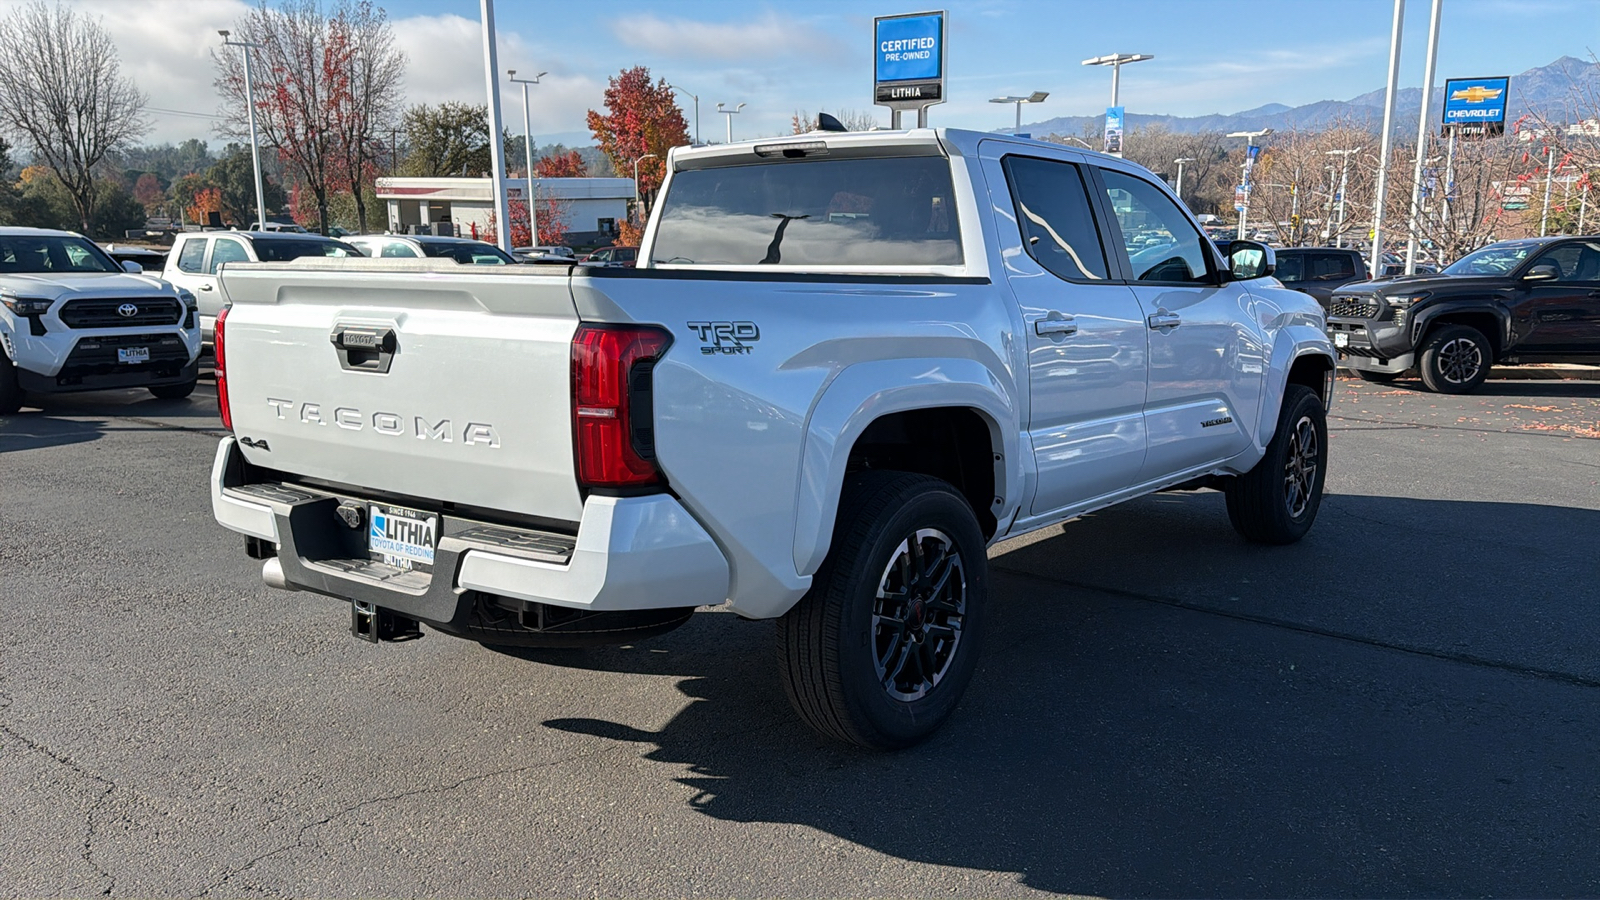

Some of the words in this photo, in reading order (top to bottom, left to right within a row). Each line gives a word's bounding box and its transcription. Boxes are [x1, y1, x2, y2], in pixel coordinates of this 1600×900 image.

[881, 38, 934, 52] CERTIFIED
[886, 50, 930, 62] PRE-OWNED
[891, 87, 921, 98] LITHIA
[1448, 108, 1500, 118] CHEVROLET
[345, 334, 374, 344] TOYOTA
[687, 321, 760, 347] TRD
[700, 346, 754, 355] SPORT
[266, 397, 501, 450] TACOMA
[389, 506, 404, 515] SINCE
[404, 510, 416, 518] 1946
[386, 518, 433, 548] LITHIA
[372, 538, 394, 550] TOYOTA
[396, 543, 404, 552] OF
[405, 545, 434, 559] REDDING
